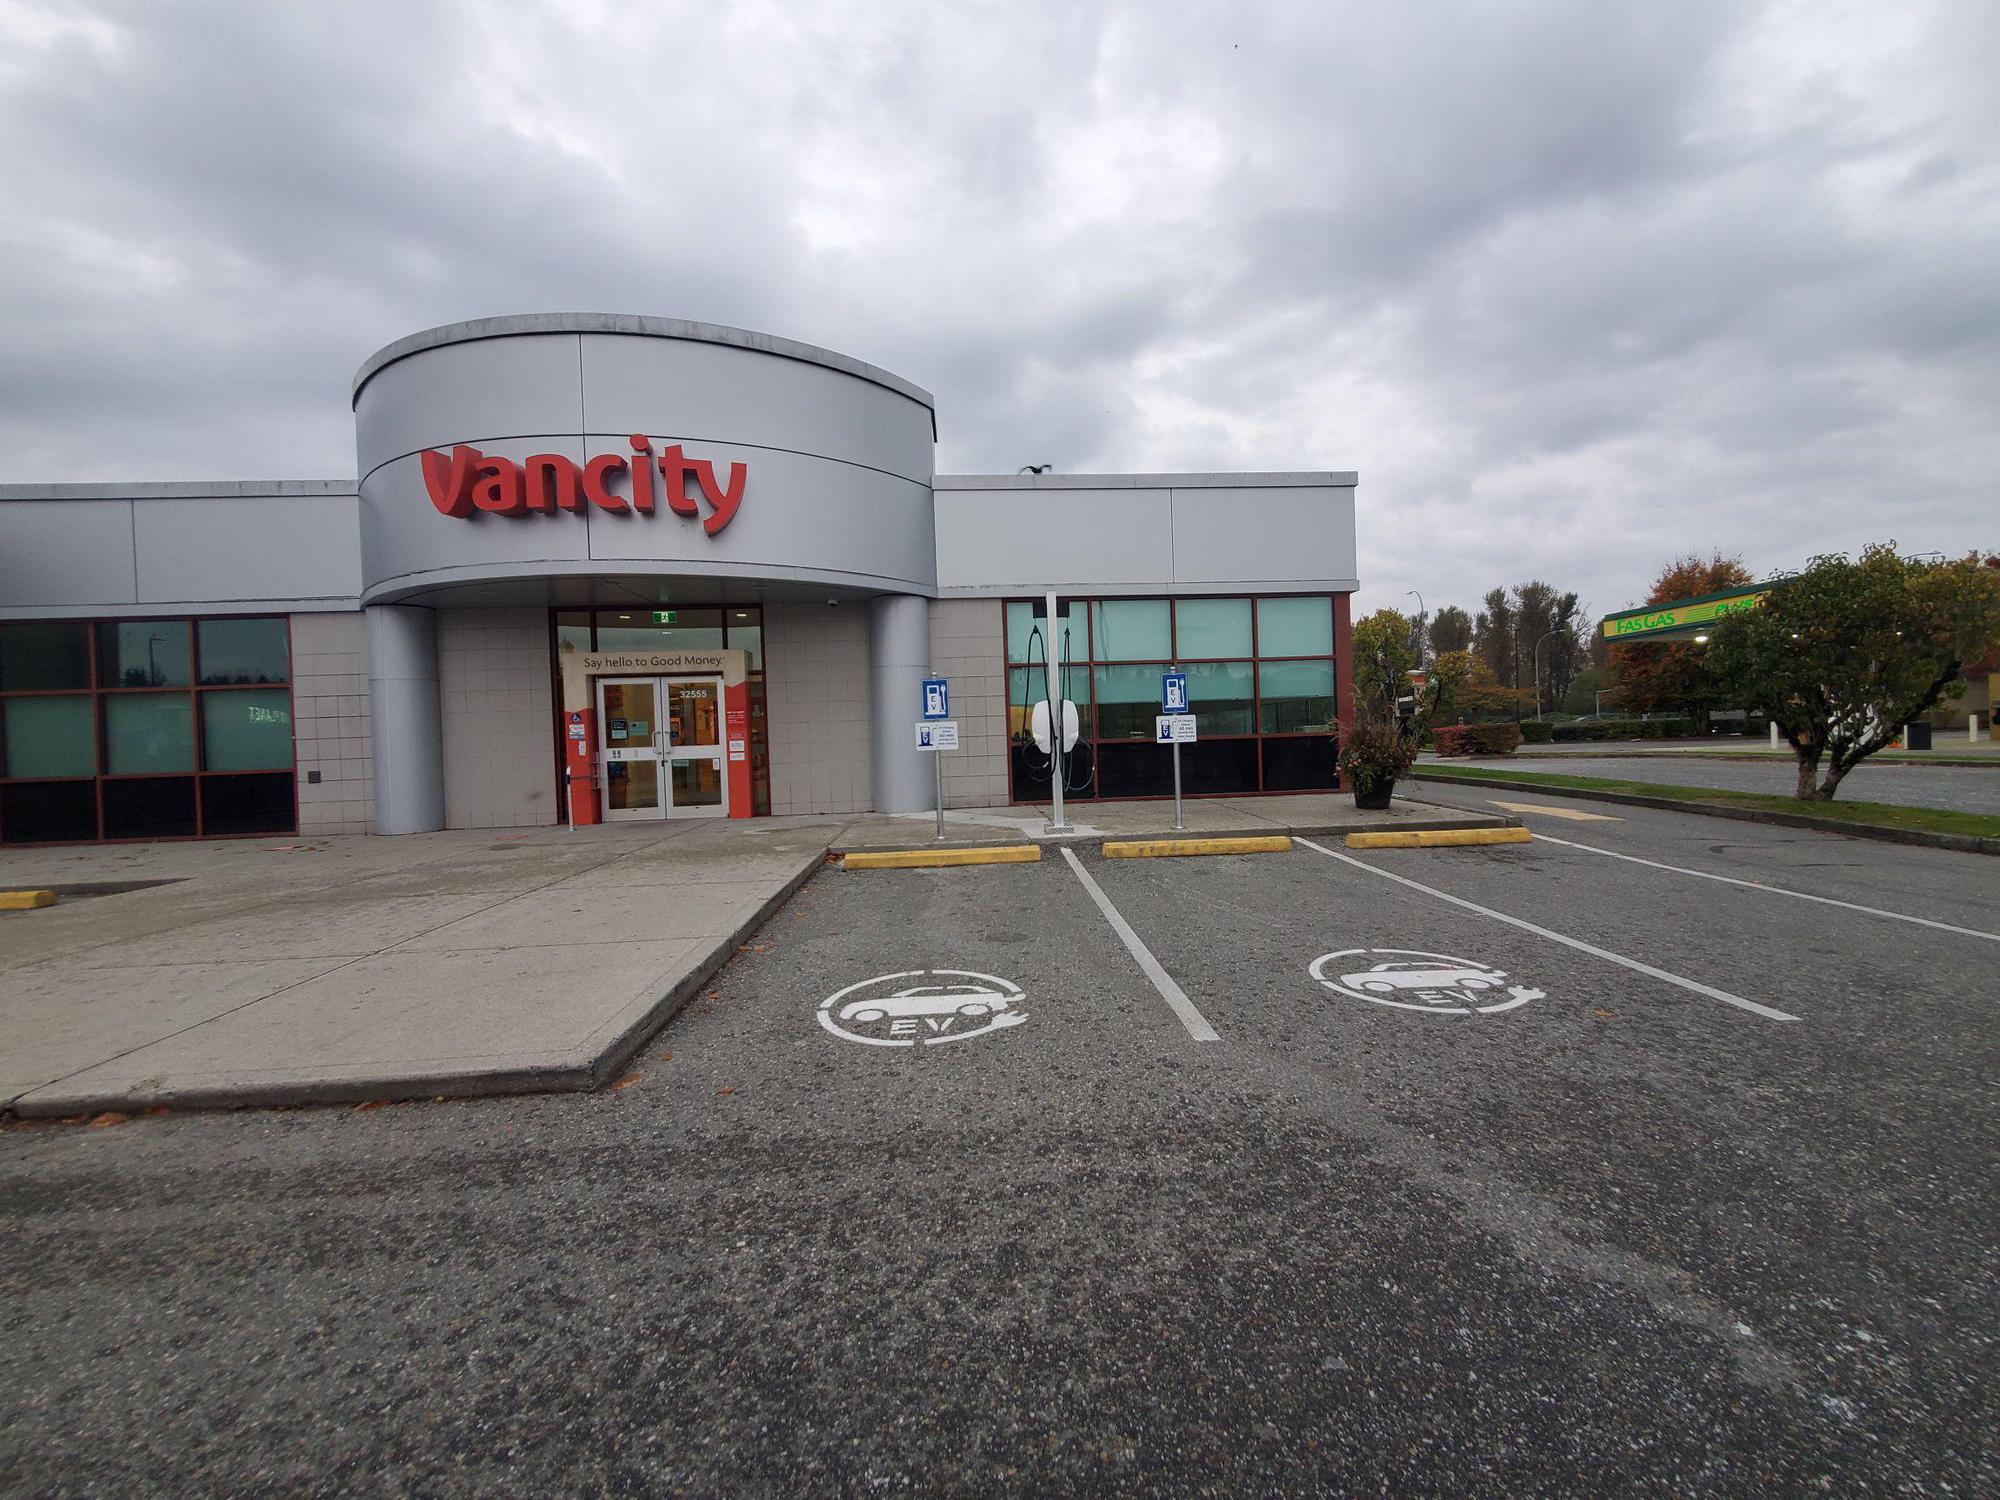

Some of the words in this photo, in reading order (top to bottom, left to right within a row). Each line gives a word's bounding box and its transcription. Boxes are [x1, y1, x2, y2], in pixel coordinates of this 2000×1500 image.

[1616, 617, 1643, 634] FAS
[1643, 611, 1676, 629] GAS
[584, 658, 602, 670] Say
[605, 656, 632, 668] hello
[635, 657, 647, 667] to
[650, 655, 681, 667] Good
[679, 689, 707, 699] 32555
[1414, 989, 1478, 1003] EV
[889, 1017, 956, 1035] EV
